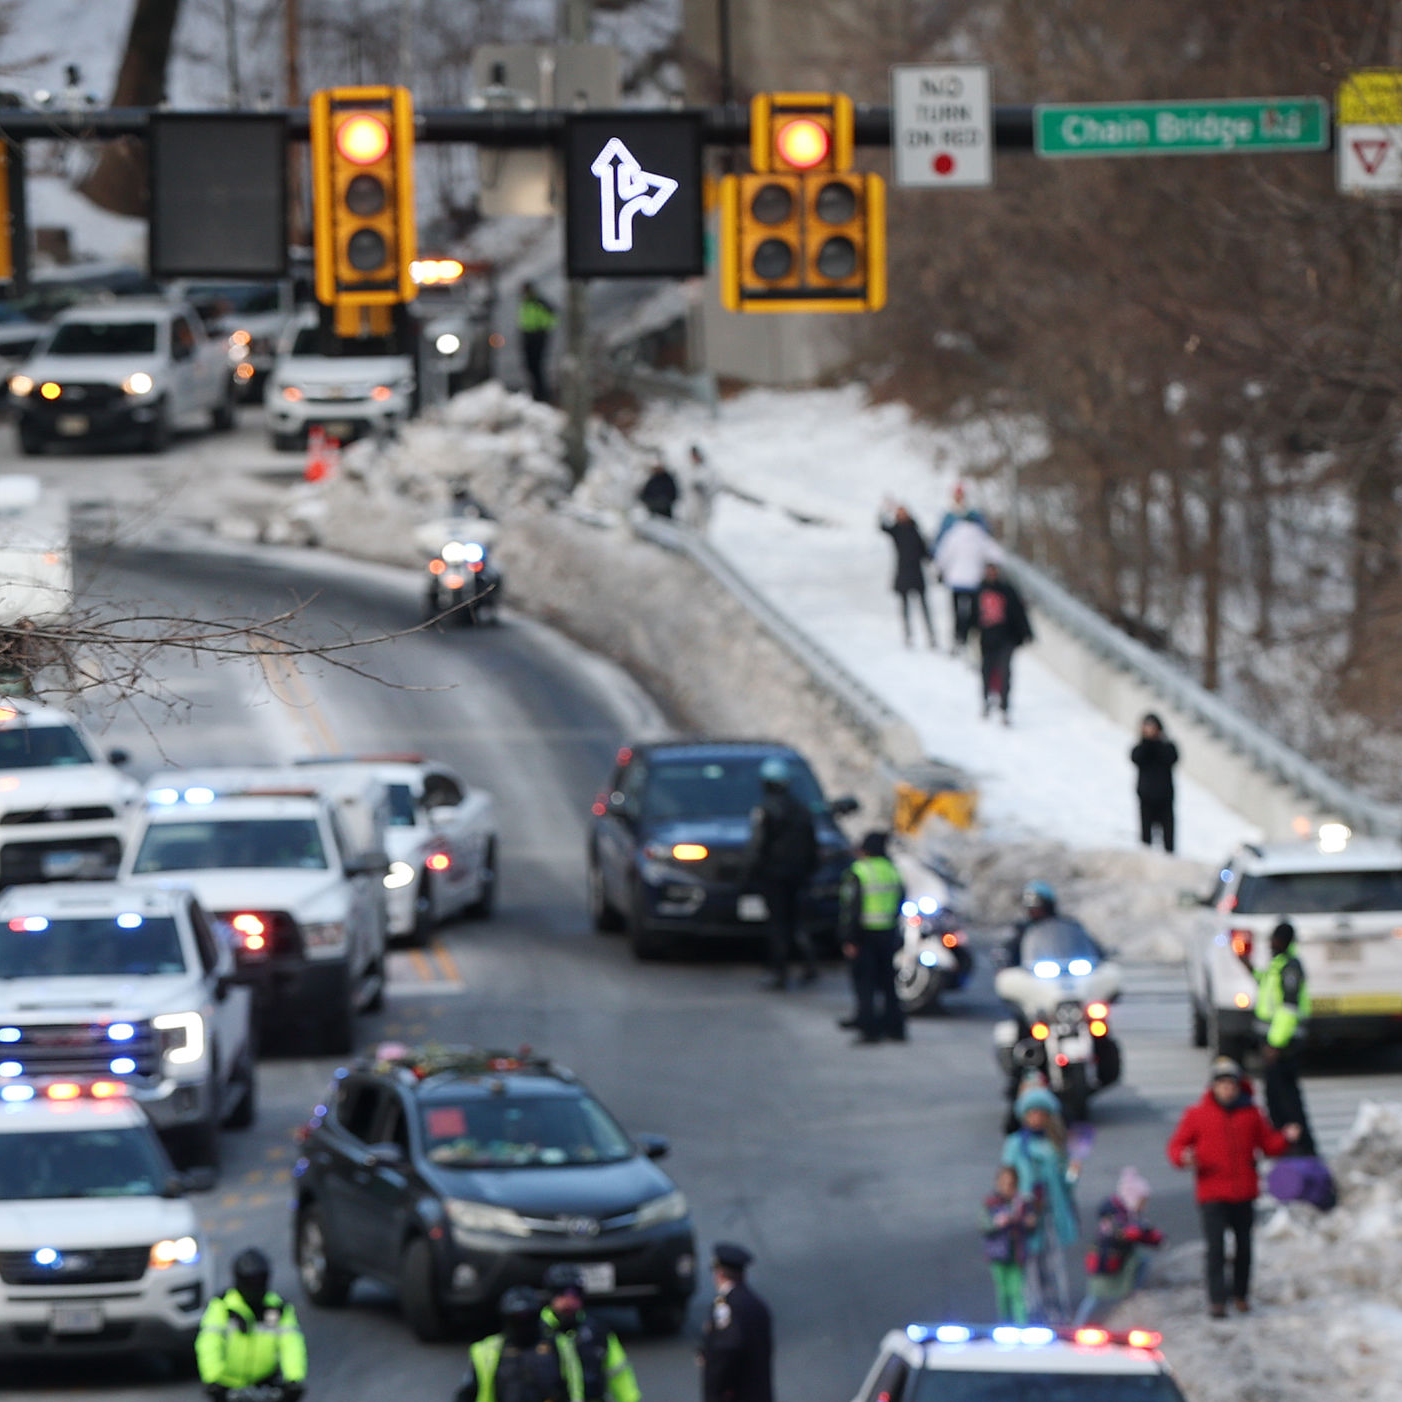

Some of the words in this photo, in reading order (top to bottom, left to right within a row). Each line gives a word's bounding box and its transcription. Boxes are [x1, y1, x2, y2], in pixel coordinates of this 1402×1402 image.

[919, 76, 964, 98] NO
[915, 104, 972, 122] TURN
[905, 129, 935, 149] ON
[940, 126, 983, 147] RED
[1061, 114, 1149, 147] Chain
[1155, 110, 1253, 150] Bridge
[1259, 107, 1301, 140] Rd
